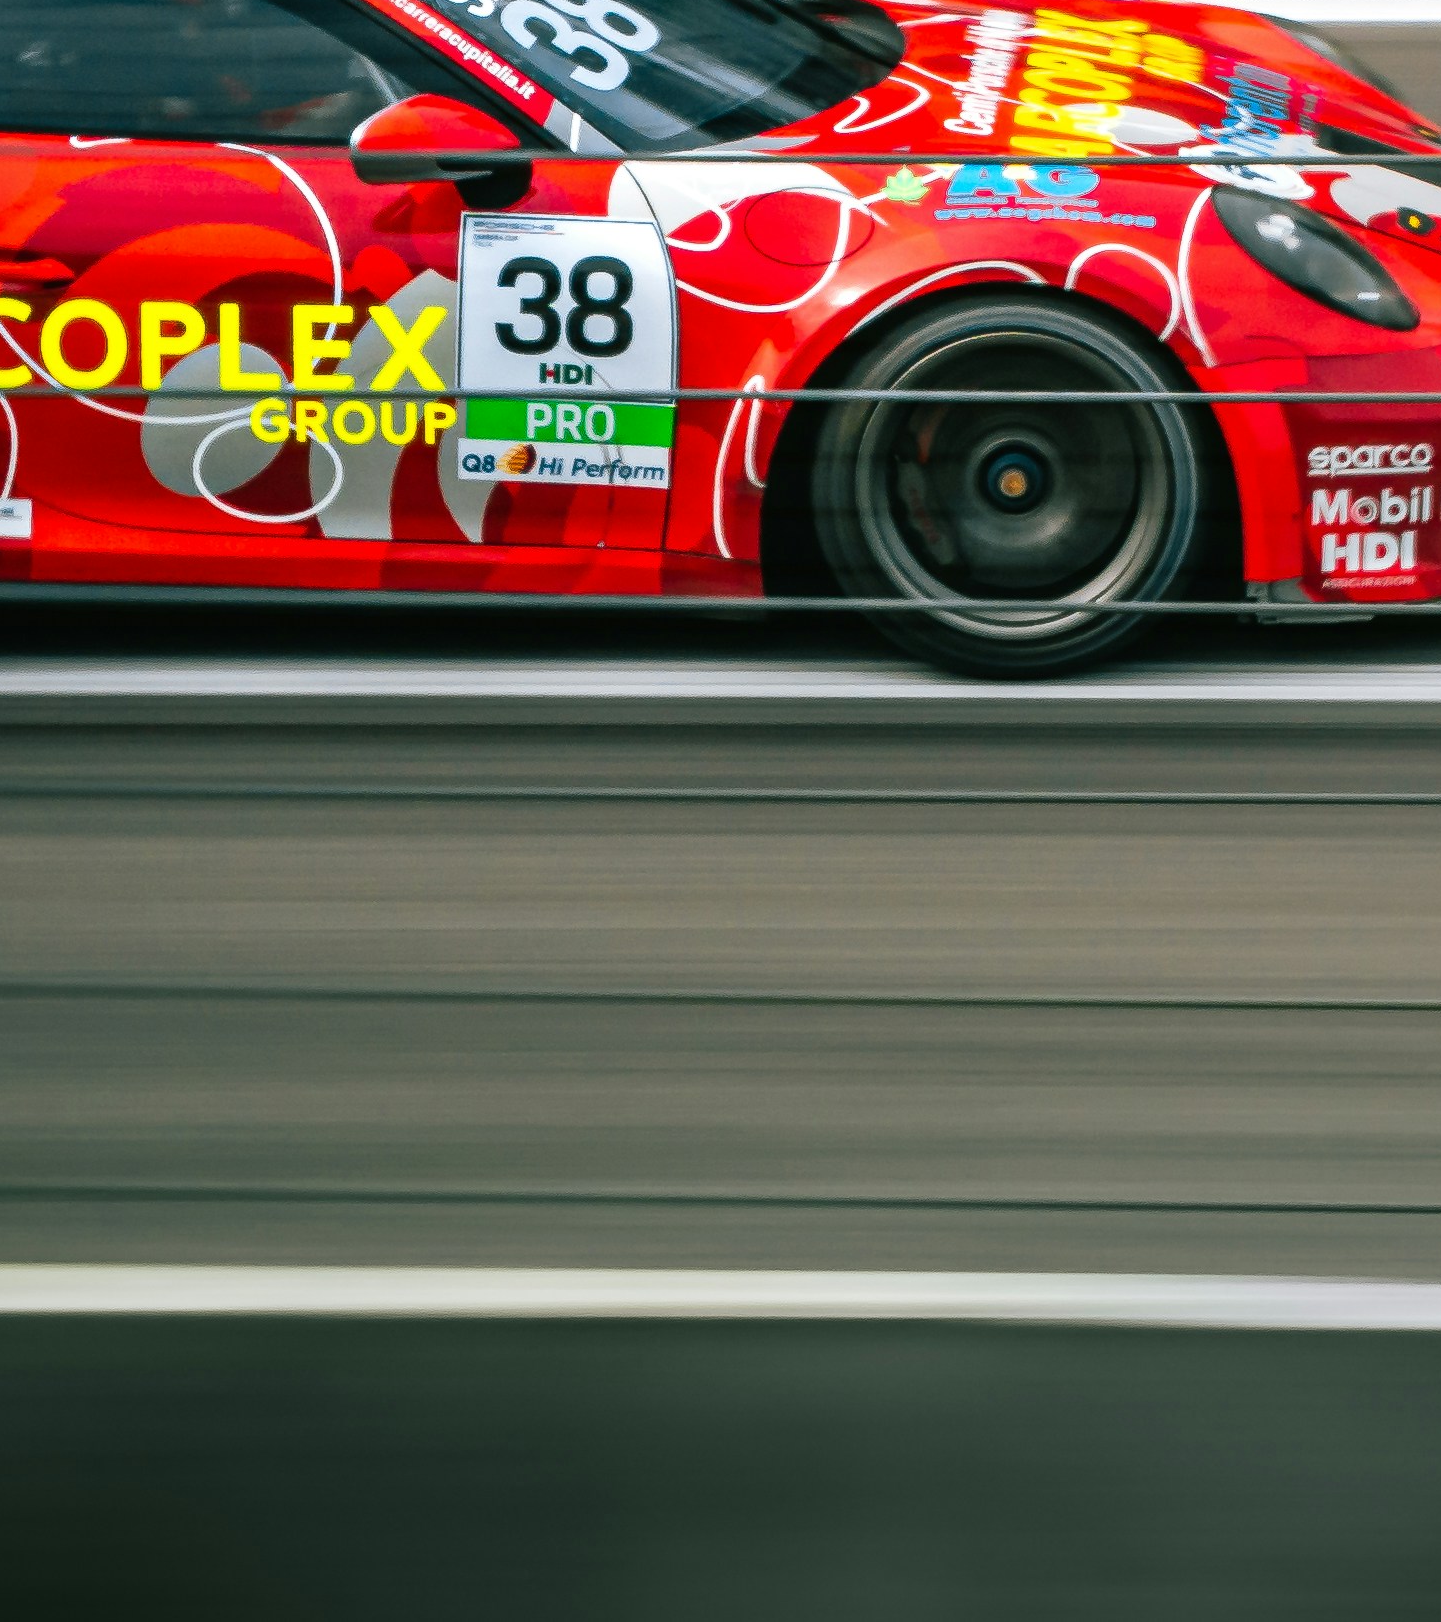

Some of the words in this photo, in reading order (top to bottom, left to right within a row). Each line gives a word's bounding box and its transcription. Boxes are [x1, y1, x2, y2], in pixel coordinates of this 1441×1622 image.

[494, 255, 634, 358] 38
[538, 362, 594, 386] HDI
[250, 397, 457, 445] GROUP
[526, 401, 616, 443] PRO
[461, 453, 496, 474] Q8
[538, 456, 565, 476] Hi
[571, 457, 666, 482] Perform
[1307, 443, 1436, 478] sparco
[1311, 484, 1434, 526] Mobil
[1321, 529, 1418, 573] HDI
